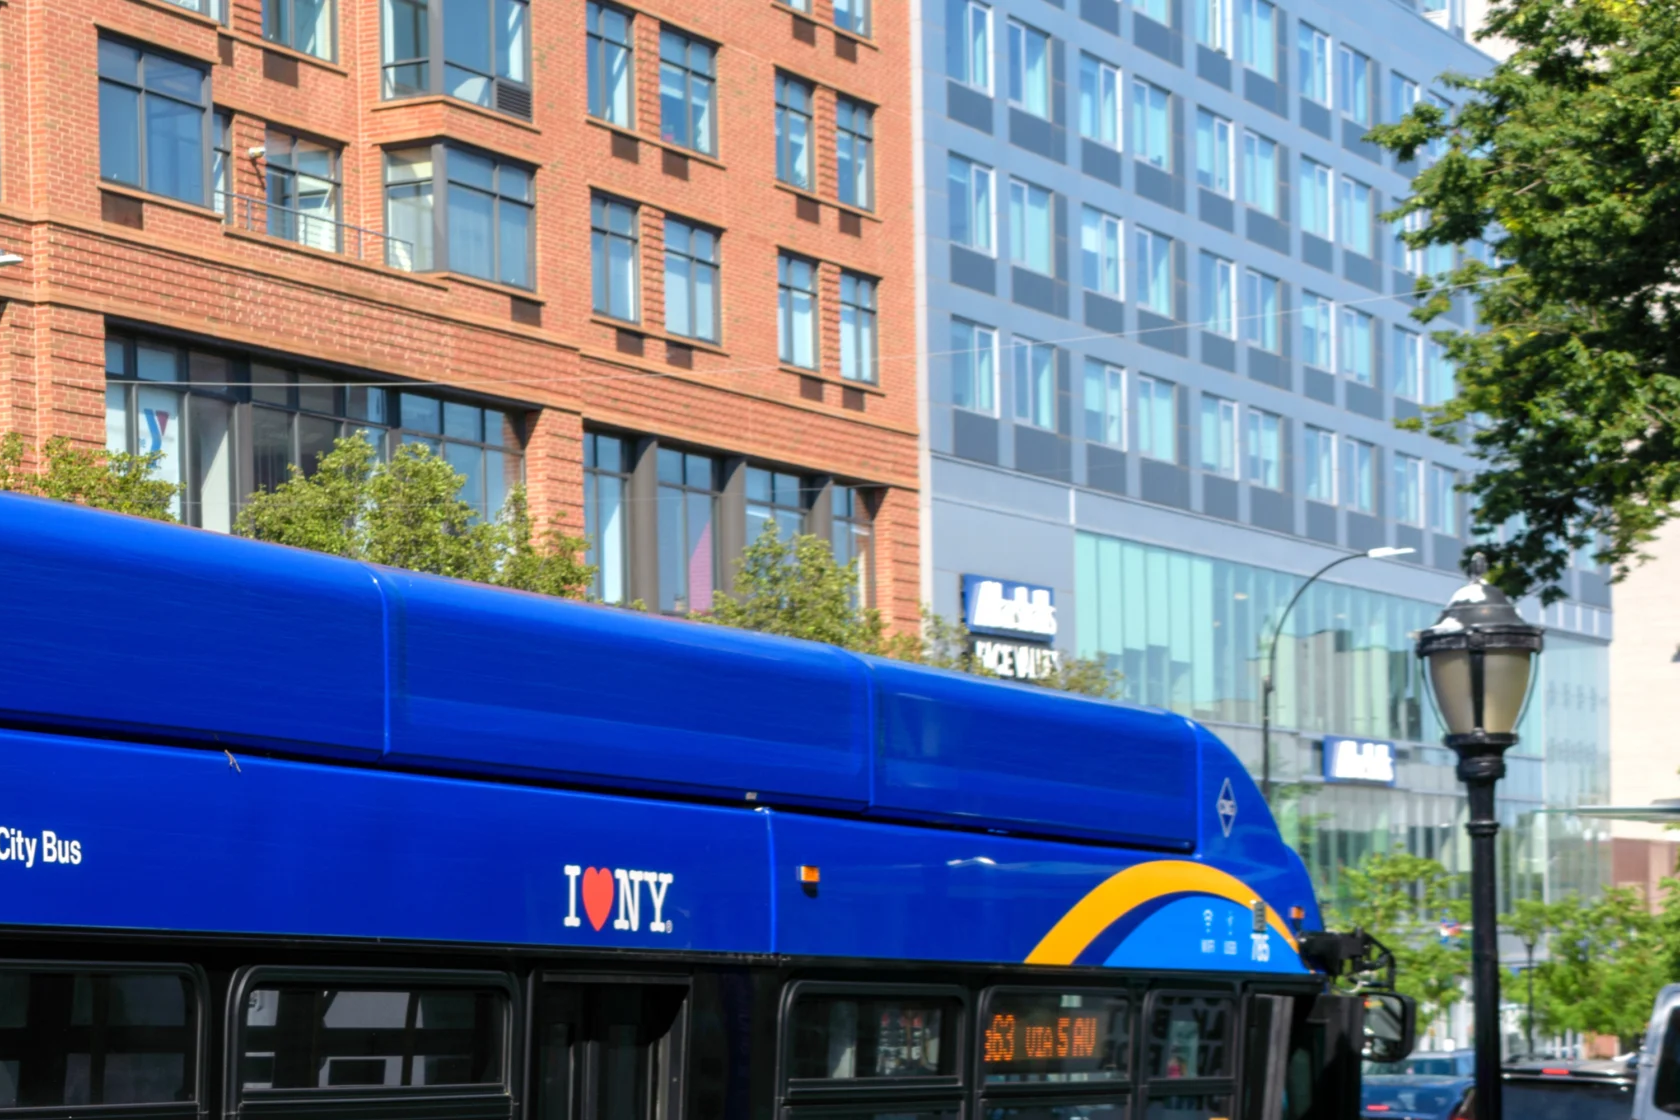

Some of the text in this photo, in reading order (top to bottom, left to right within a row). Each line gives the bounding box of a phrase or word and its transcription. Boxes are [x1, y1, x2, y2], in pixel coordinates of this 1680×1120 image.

[42, 830, 82, 865] Bus
[564, 865, 673, 933] I NY
[1026, 1026, 1053, 1057] VIA
[1057, 1018, 1070, 1056] 5
[1072, 1018, 1096, 1056] AV
